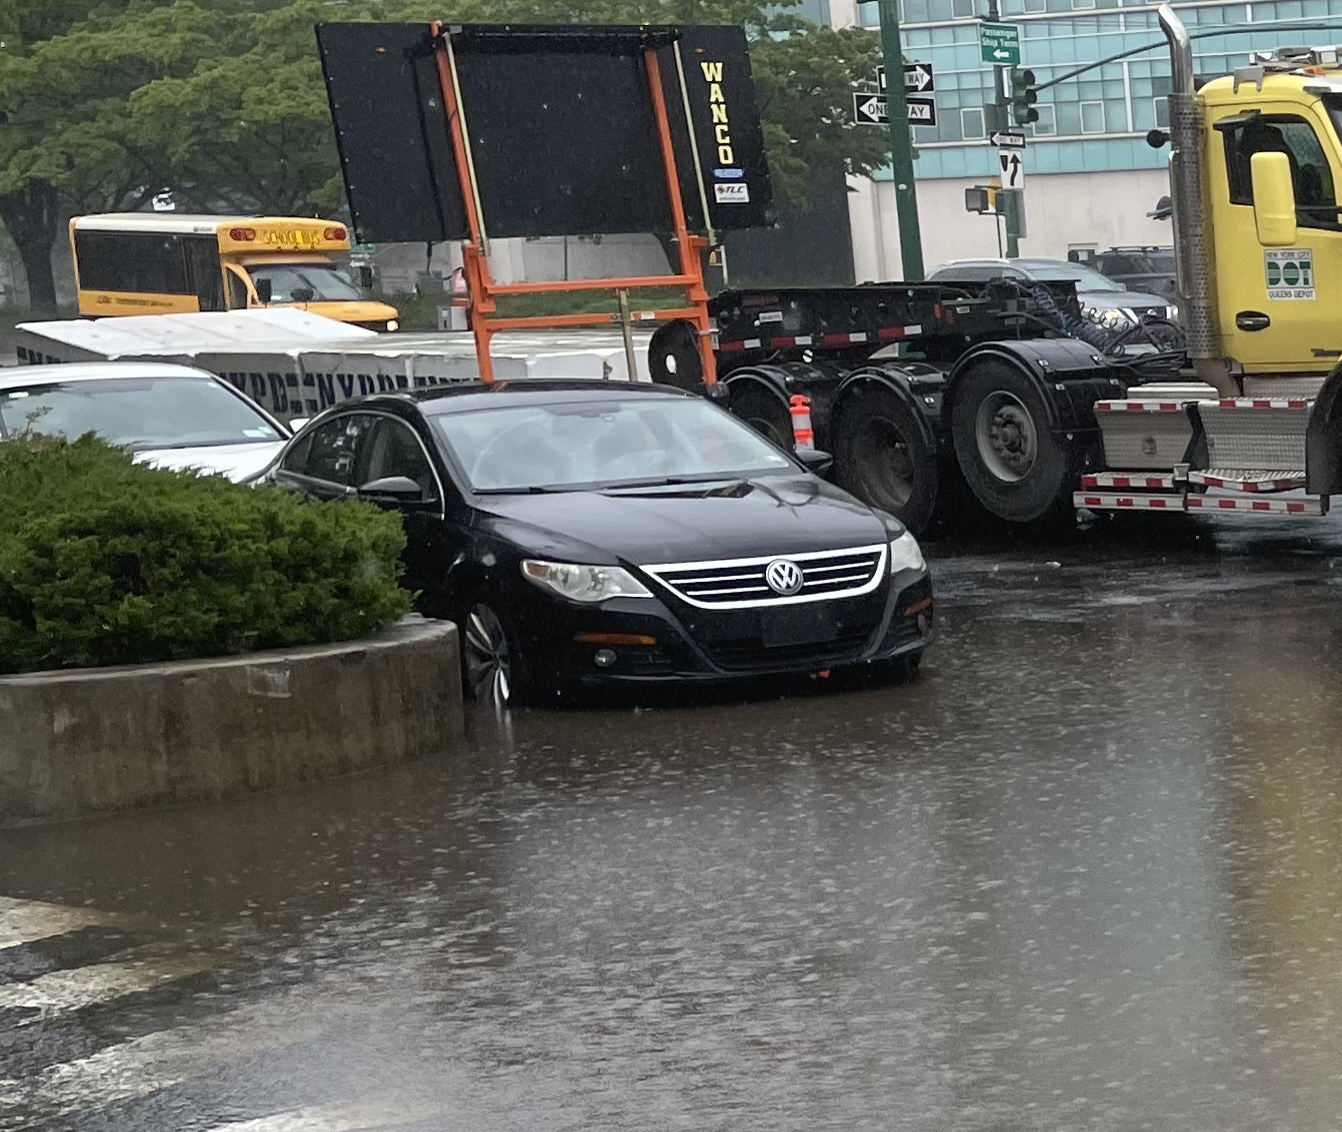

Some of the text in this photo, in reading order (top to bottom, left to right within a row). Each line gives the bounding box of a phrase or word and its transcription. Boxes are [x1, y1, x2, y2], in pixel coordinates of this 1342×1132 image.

[907, 73, 924, 86] WAY
[700, 62, 734, 165] WANCO
[910, 106, 924, 117] AY
[263, 230, 320, 245] SCHOOL BUS
[1267, 261, 1311, 286] DOT
[1268, 289, 1314, 298] QUEENS DEPOT
